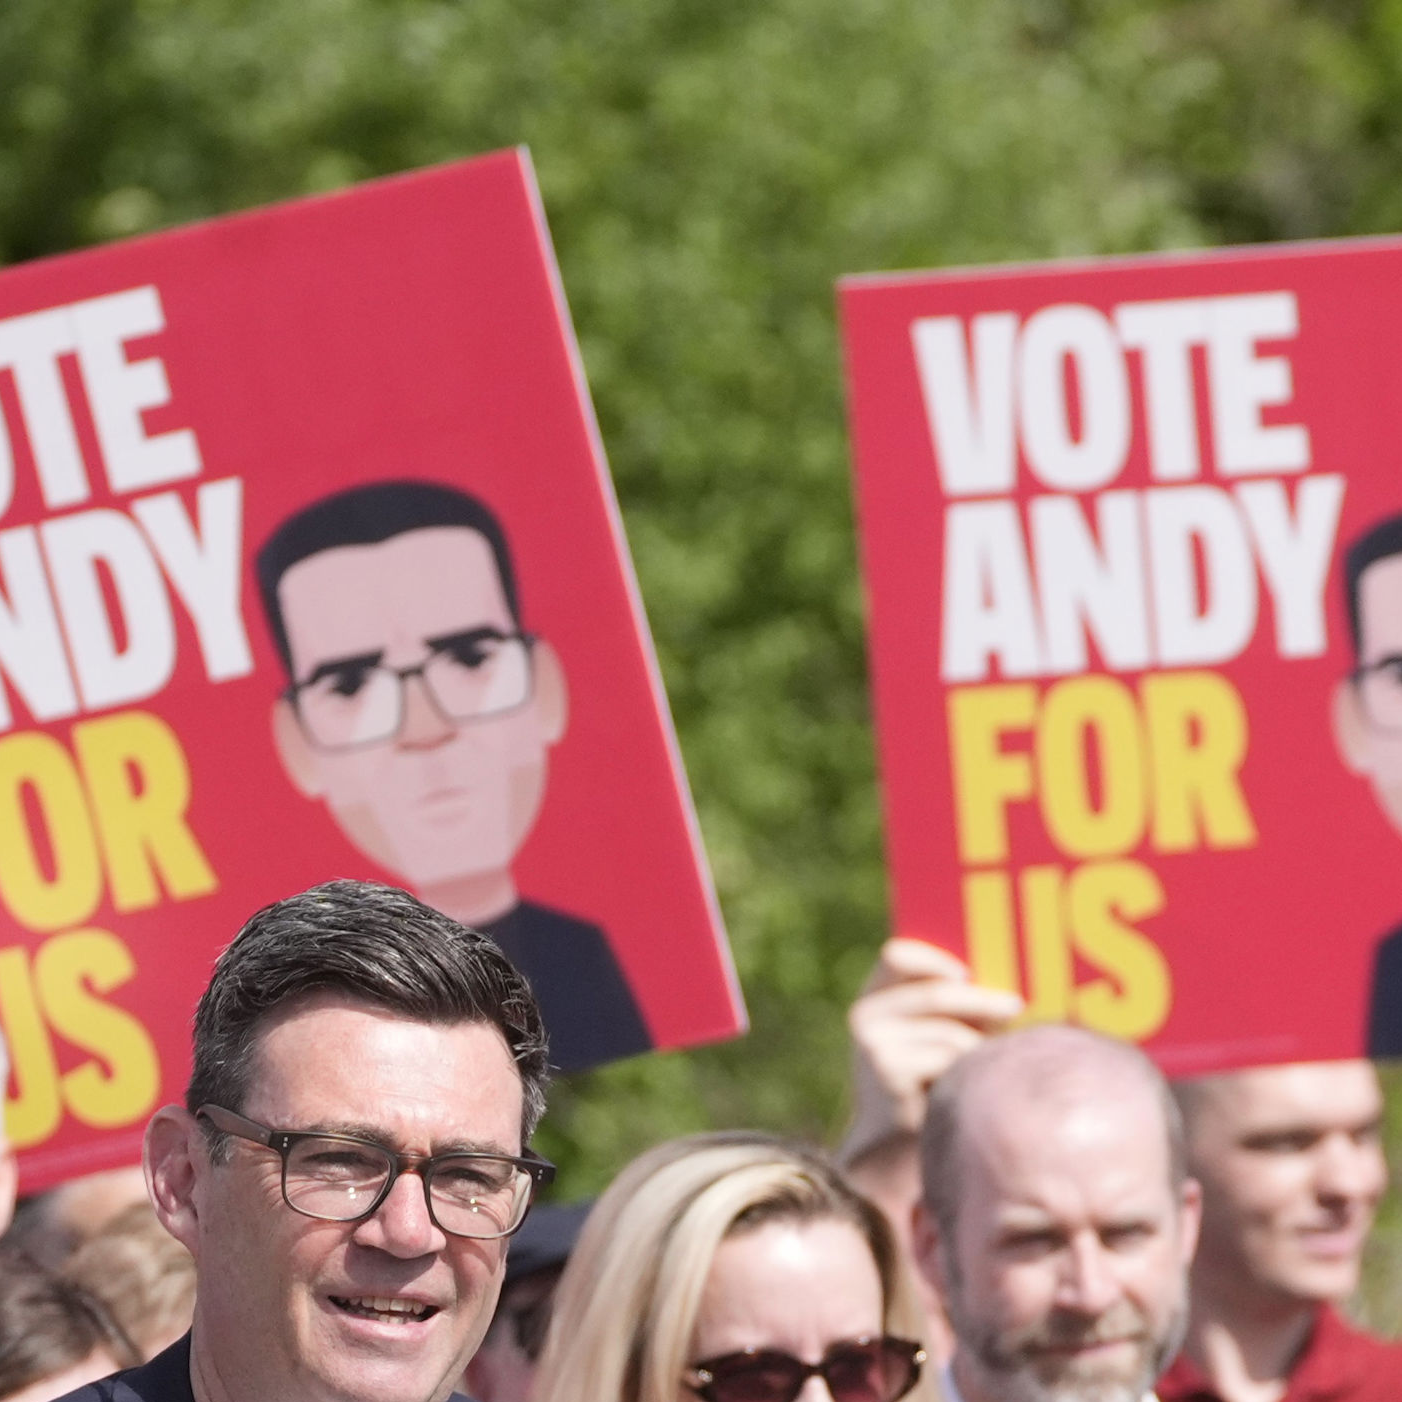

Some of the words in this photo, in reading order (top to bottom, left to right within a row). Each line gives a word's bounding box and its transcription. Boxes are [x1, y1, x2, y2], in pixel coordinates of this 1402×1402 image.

[910, 291, 1311, 497] VOTE
[939, 473, 1346, 684] ANDY
[946, 670, 1258, 865] FOR
[961, 859, 1172, 1042] US
